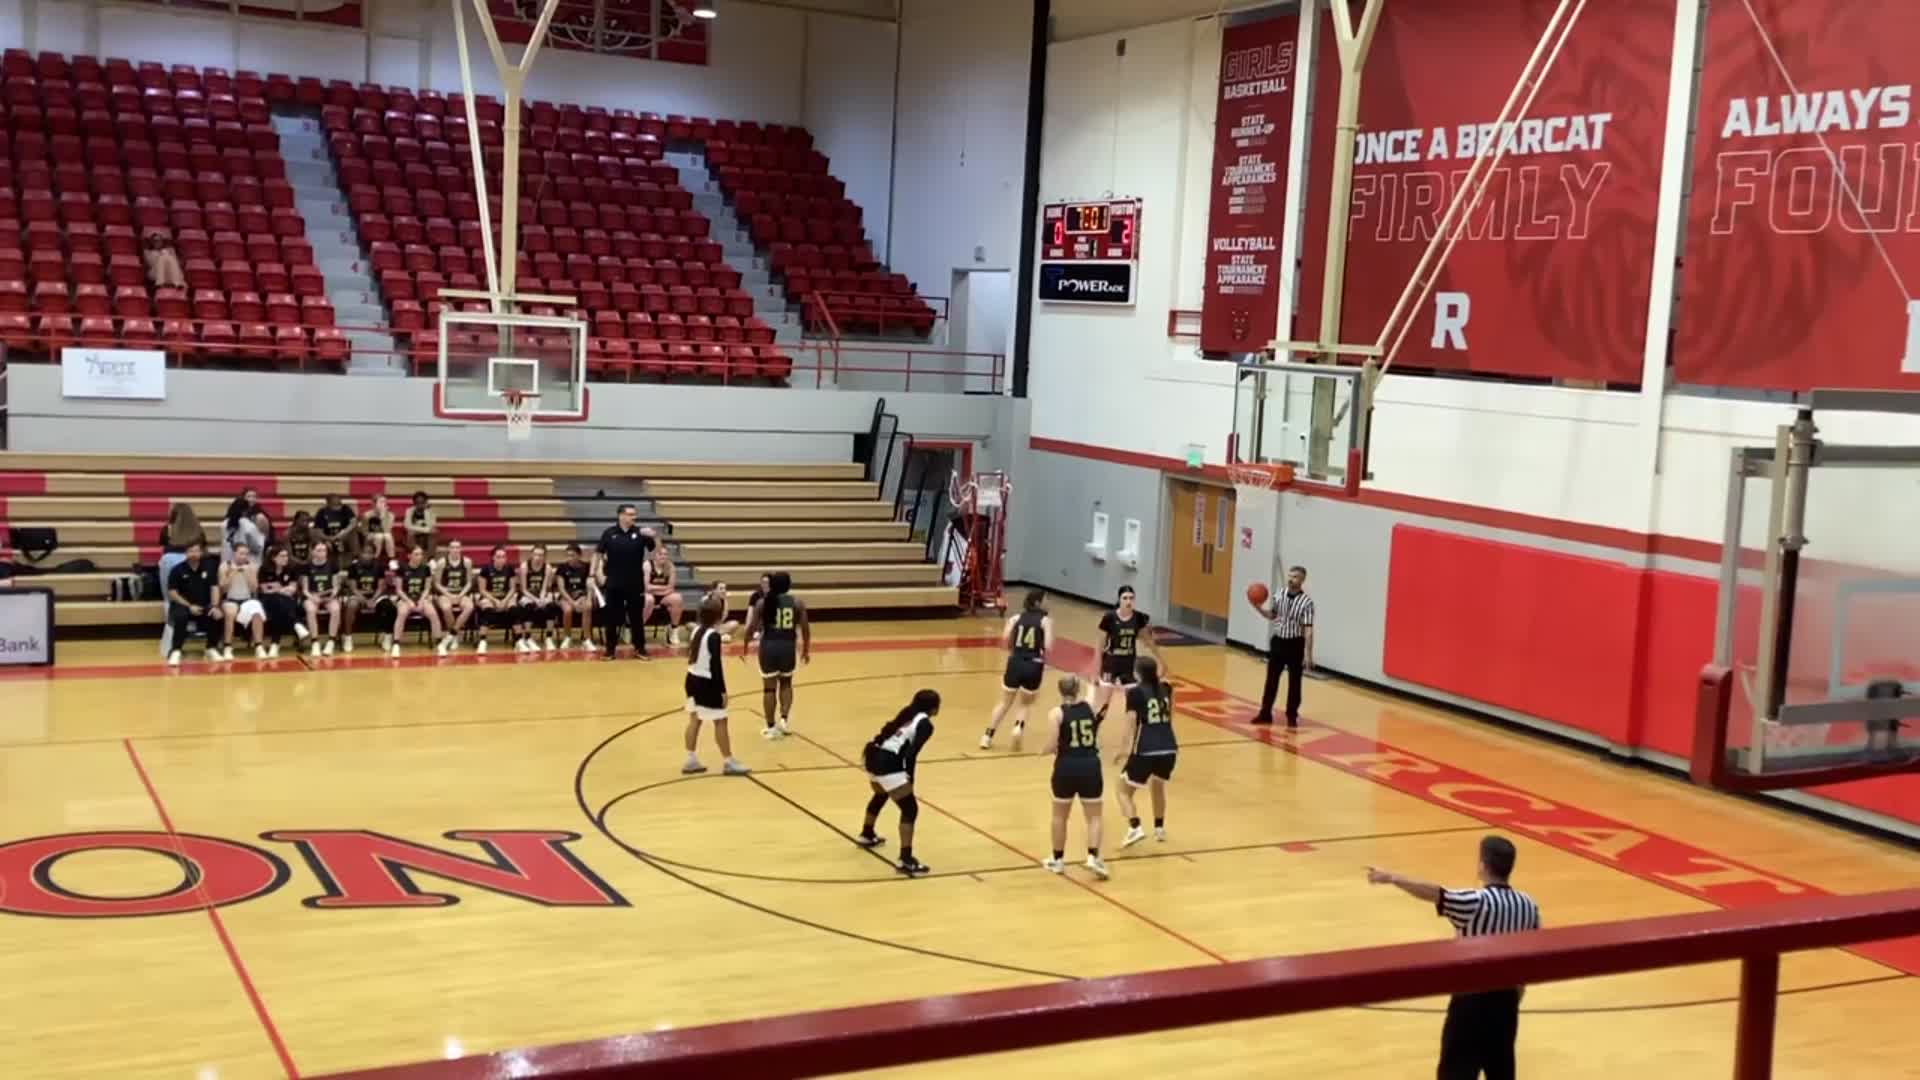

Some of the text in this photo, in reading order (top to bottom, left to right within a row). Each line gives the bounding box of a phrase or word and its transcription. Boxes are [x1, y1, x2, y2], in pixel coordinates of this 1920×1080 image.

[1223, 41, 1294, 83] GIRLS
[1223, 77, 1288, 100] BASKETBALL
[1721, 85, 1911, 138] ALWAYS
[1427, 127, 1449, 160] A
[1455, 112, 1612, 159] BEARCAT
[1348, 162, 1612, 242] FIRMLY
[1710, 142, 1920, 235] FOU
[1054, 220, 1063, 245] 0
[1122, 219, 1132, 244] 2
[1213, 237, 1276, 251] VOLLEYBALL
[1431, 292, 1470, 350] R
[0, 636, 39, 653] Bank
[1016, 624, 1036, 649] 14
[1069, 719, 1094, 748] 15
